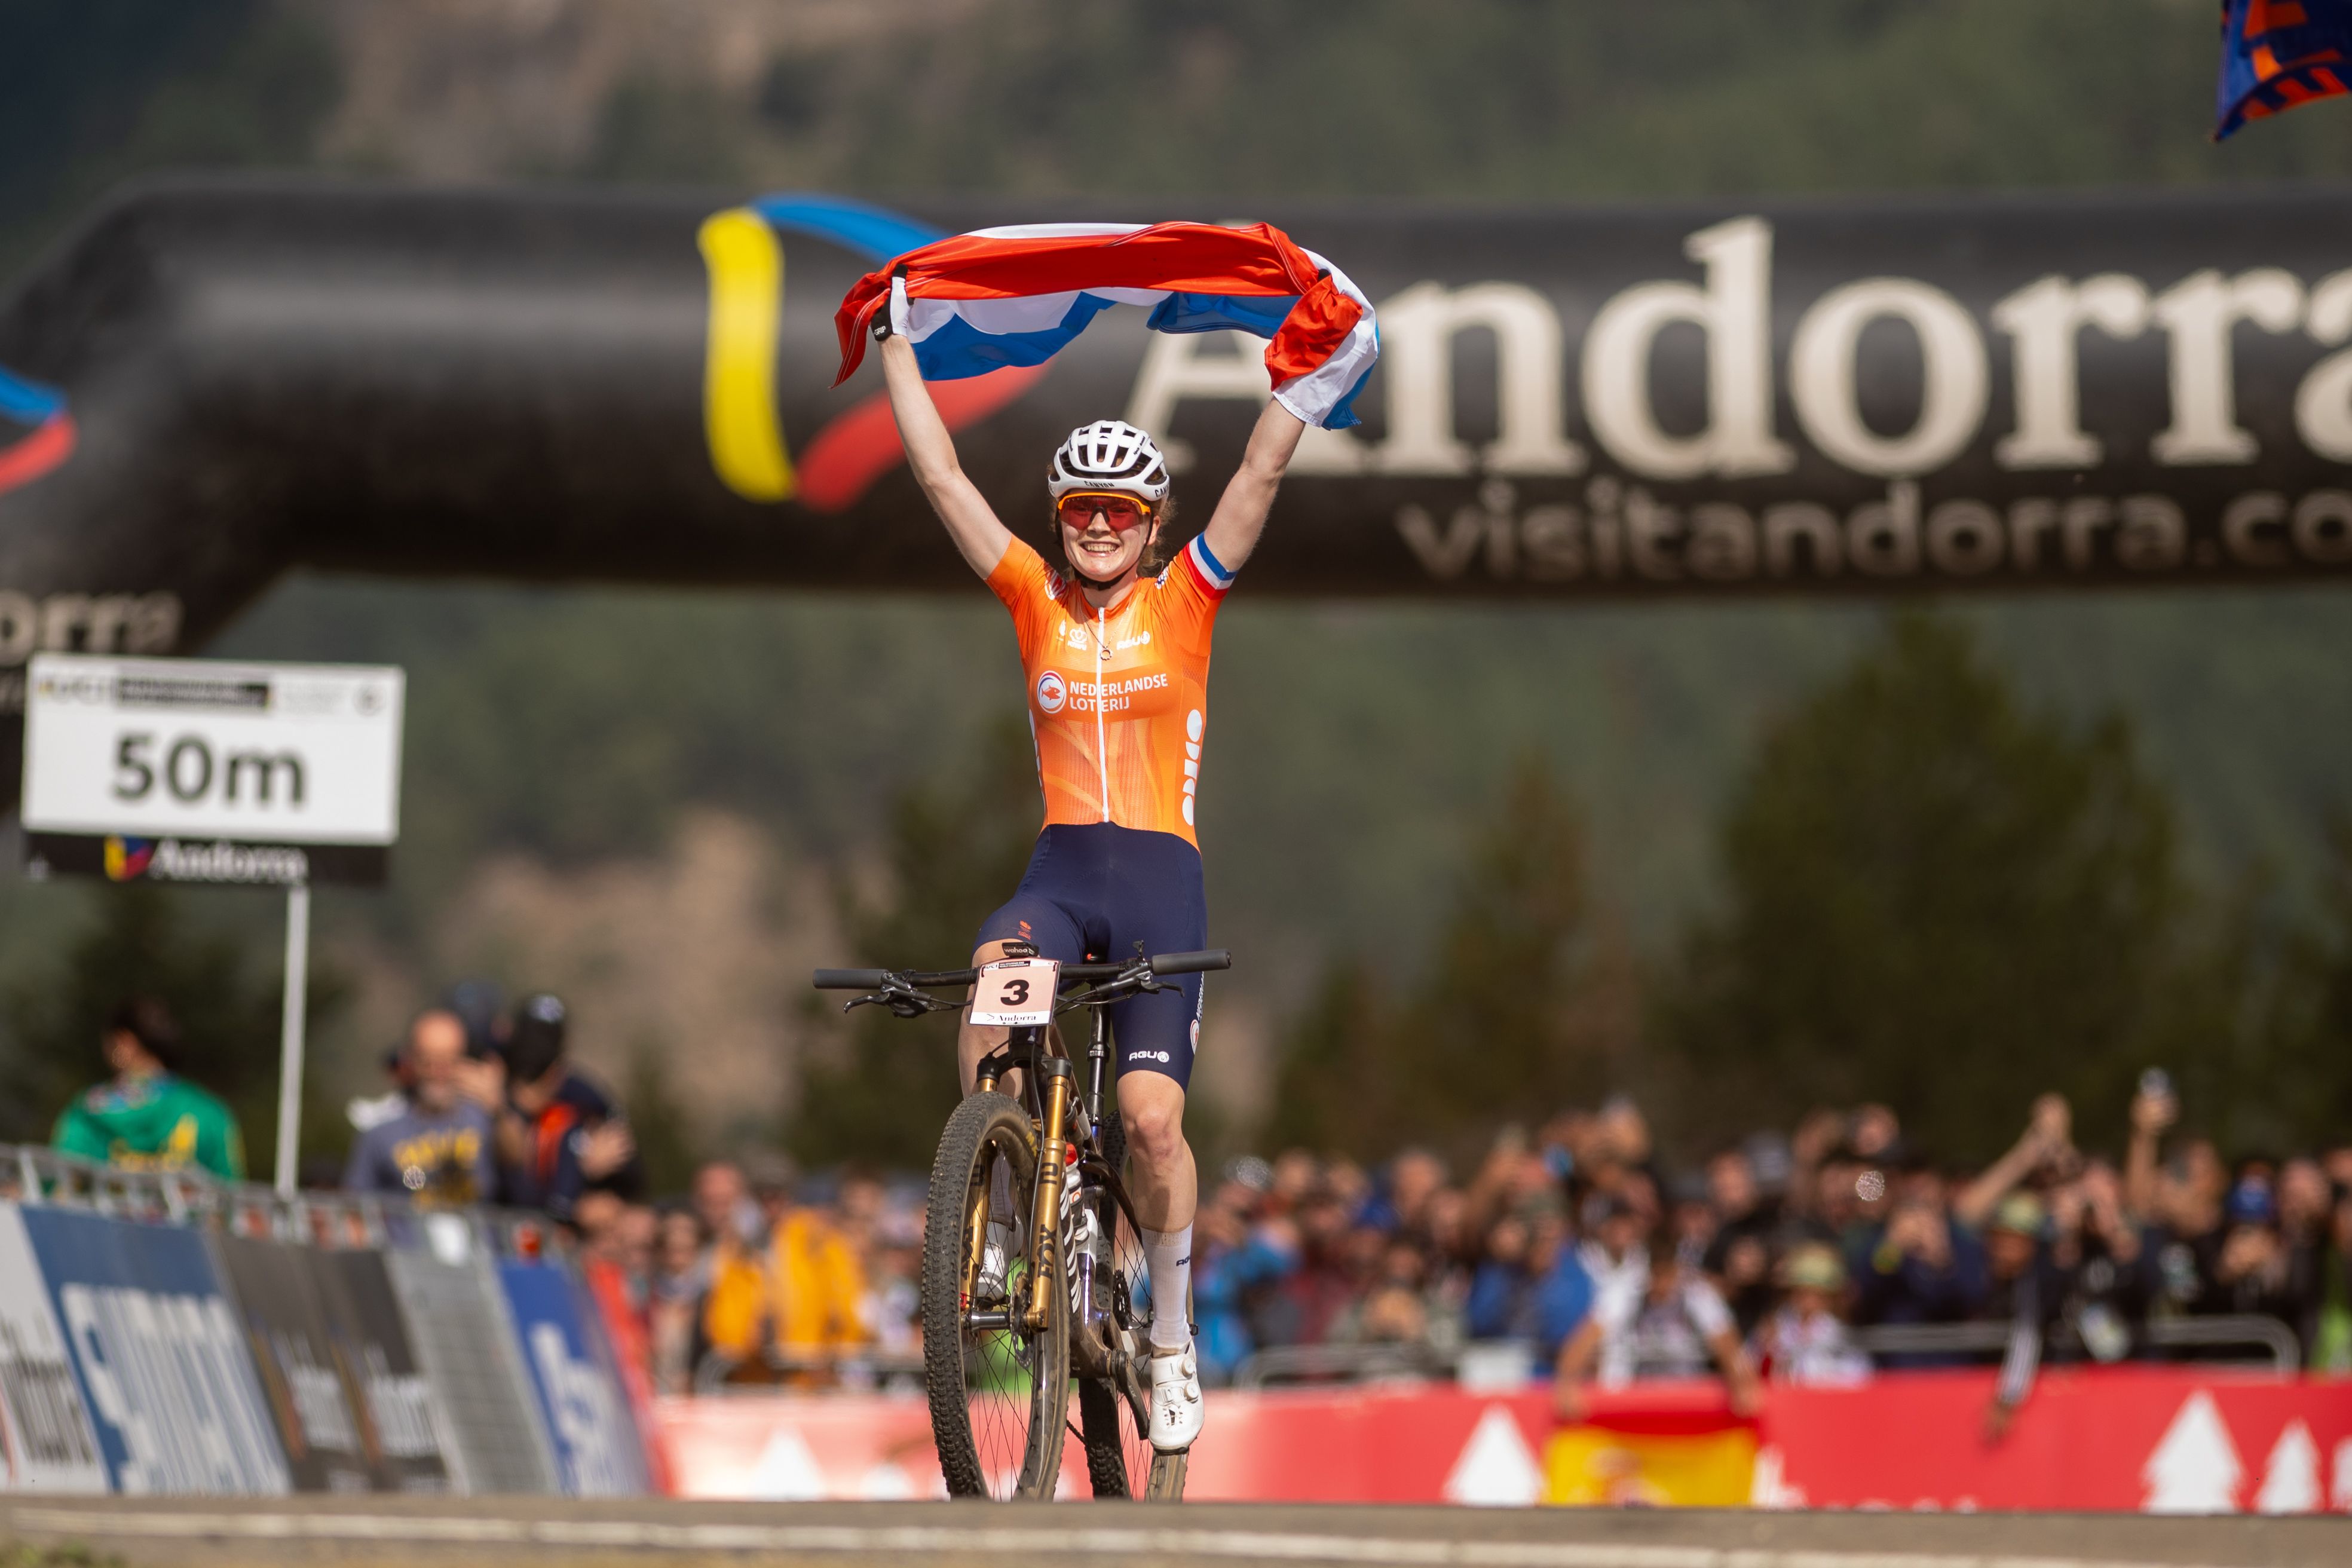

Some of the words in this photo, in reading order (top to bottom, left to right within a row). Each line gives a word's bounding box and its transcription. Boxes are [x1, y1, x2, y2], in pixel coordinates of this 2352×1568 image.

[1084, 480, 1115, 488] CANYON
[1070, 673, 1168, 697] NEDERLANDSE
[1070, 696, 1130, 712] LOTERIJ
[111, 729, 307, 810] 50m
[151, 838, 308, 884] Andorra
[1000, 979, 1030, 1006] 3
[1129, 1051, 1157, 1061] AGU
[1036, 1223, 1056, 1279] FOX
[1176, 1255, 1190, 1266] AG
